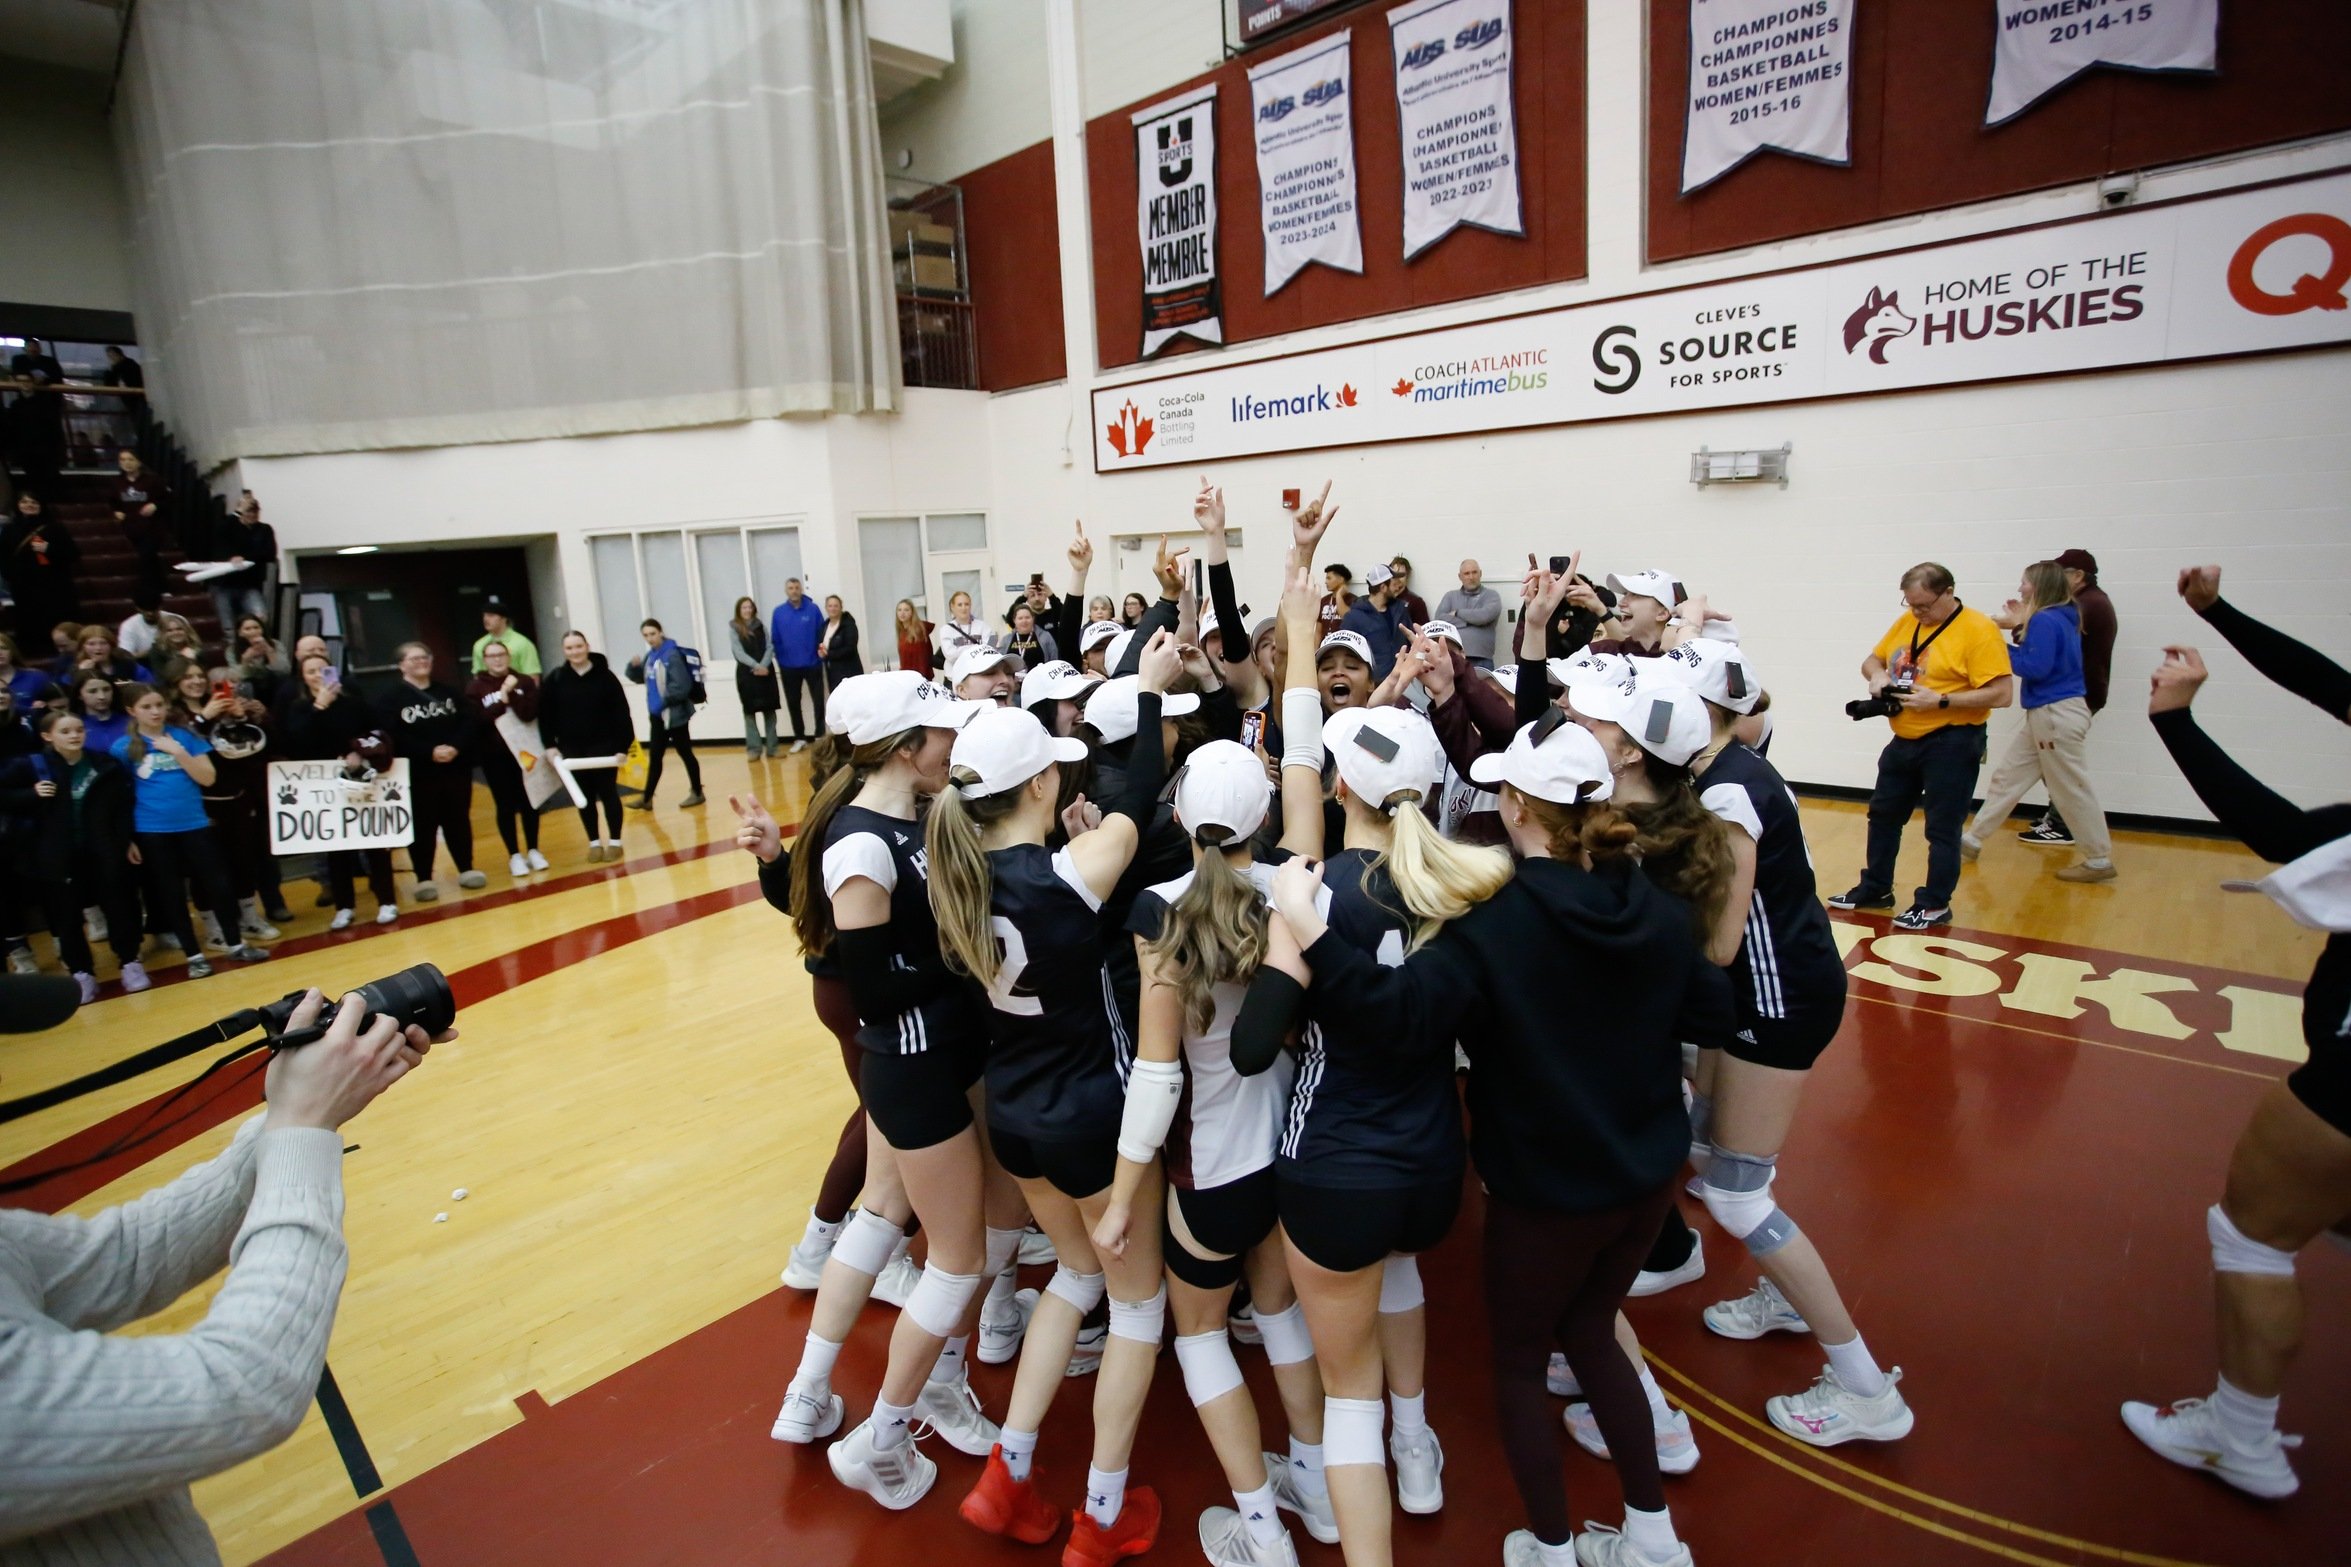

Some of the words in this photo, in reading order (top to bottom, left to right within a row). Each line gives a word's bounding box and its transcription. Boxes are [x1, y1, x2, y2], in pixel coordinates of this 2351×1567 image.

[1713, 0, 1827, 44] CHAMPIONS
[2049, 4, 2152, 44] 2014-15
[1701, 17, 1839, 68] CHAMPIONNES
[1707, 44, 1829, 88] BASKETBALL
[1695, 62, 1842, 112] WOMEN/FEMMES
[1417, 104, 1496, 139] CHAMPIONS
[1730, 95, 1801, 125] 2015-16
[1158, 142, 1193, 164] SPORTS
[1430, 178, 1492, 206] 2022-2023
[1149, 184, 1206, 240] MEMBER
[1147, 232, 1209, 286] MEMBRE
[1925, 273, 2011, 305] HOME
[2026, 264, 2068, 290] OF
[2081, 252, 2147, 281] THE
[1695, 304, 1761, 325] CLEVE'S
[1923, 284, 2143, 346] HUSKIES
[1660, 324, 1797, 365] SOURCE
[1414, 361, 1467, 381] COACH
[1471, 349, 1548, 374] ATLANTIC
[1670, 374, 1703, 388] FOR
[1713, 363, 1783, 383] SPORTS
[1159, 392, 1205, 407] Coca-Cola
[1232, 384, 1330, 422] lifemark
[1414, 371, 1548, 403] maritimebus
[1159, 407, 1193, 420] Canada
[1160, 420, 1195, 434] Bottling
[1160, 433, 1194, 447] Limited
[310, 789, 335, 804] TO
[277, 810, 335, 842] DOG
[342, 806, 410, 838] POUND
